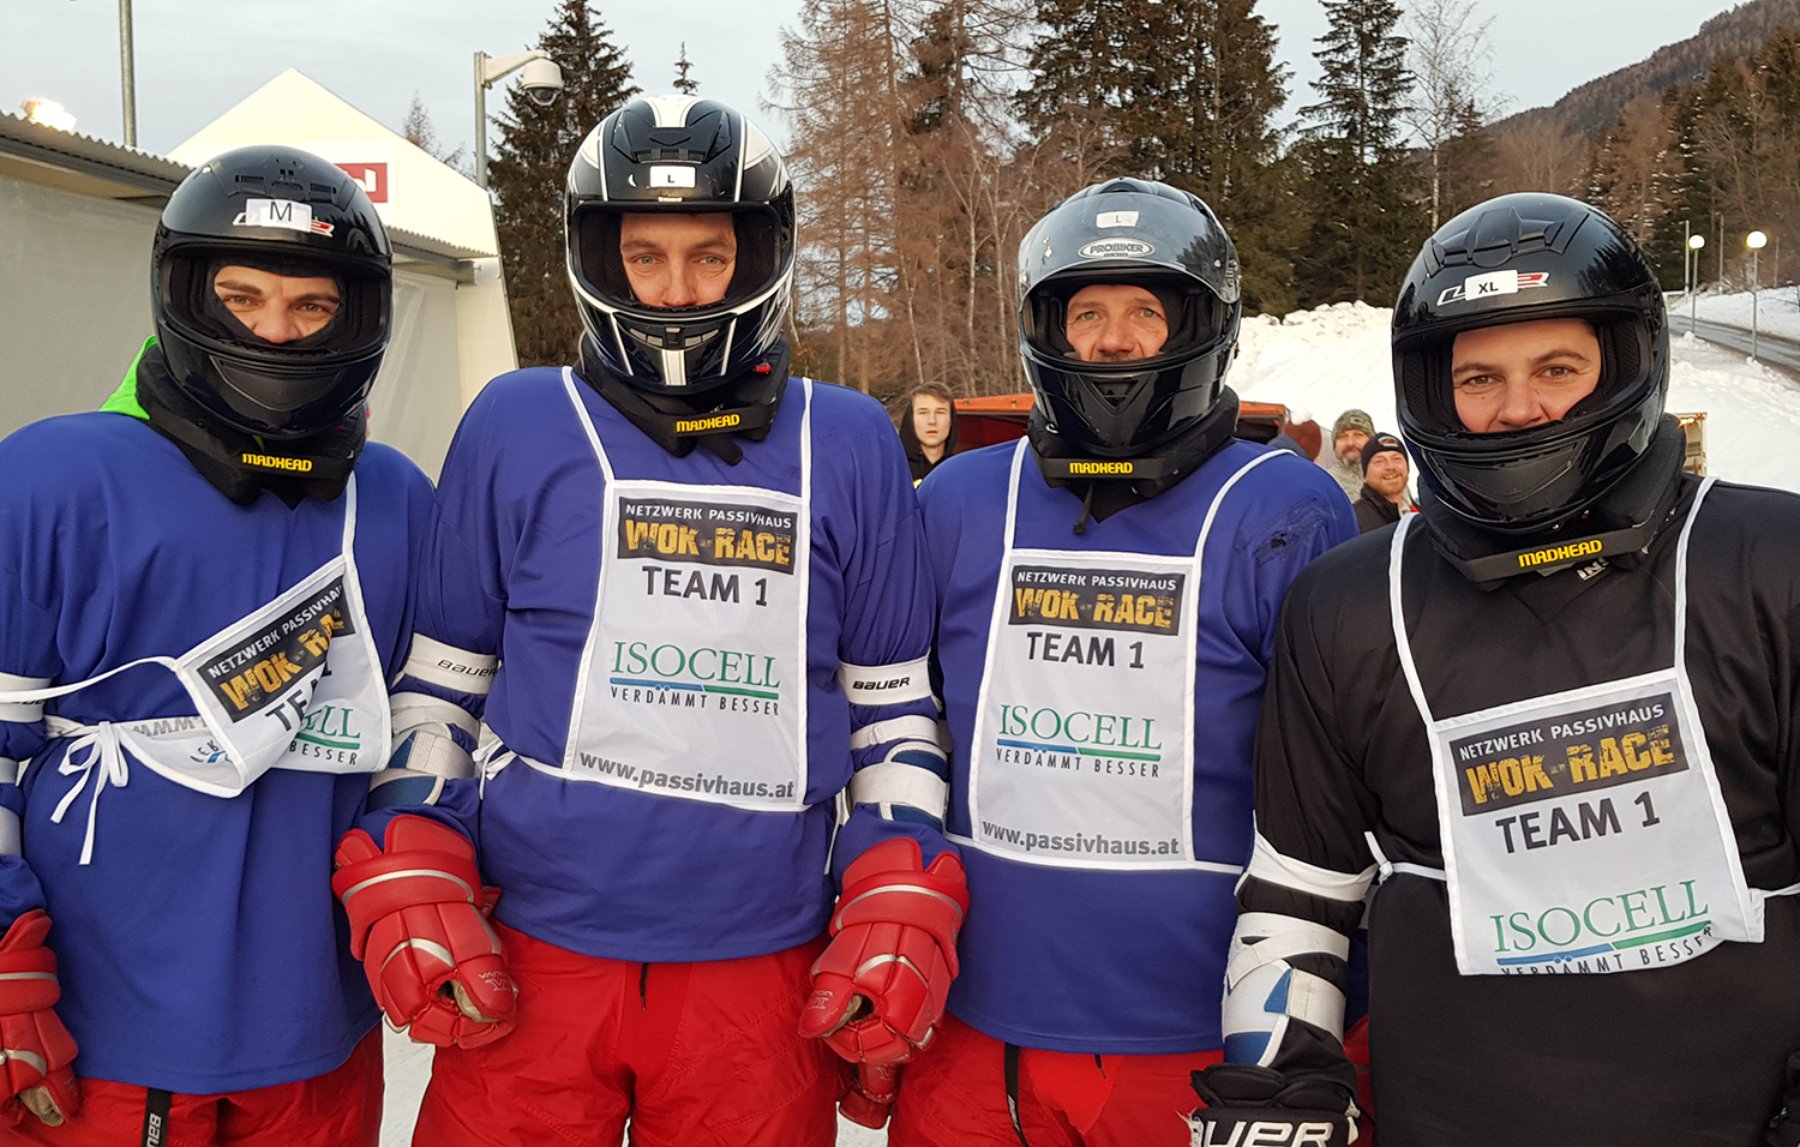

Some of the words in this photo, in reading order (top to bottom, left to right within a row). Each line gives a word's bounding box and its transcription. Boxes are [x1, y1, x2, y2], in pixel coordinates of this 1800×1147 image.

[667, 174, 676, 184] L
[269, 201, 292, 222] M
[1115, 215, 1122, 224] L
[1090, 243, 1144, 254] PROBIKER
[1478, 281, 1499, 295] XL
[676, 413, 740, 433] MADHEAD
[241, 453, 313, 472] MADHEAD
[1069, 462, 1133, 474] MADHEAD
[625, 503, 703, 520] NETZWERK
[709, 508, 792, 529] PASSIVHAUS
[625, 518, 700, 555] WOK
[715, 527, 793, 566] RACE
[1518, 539, 1603, 567] MADHEAD
[642, 565, 741, 604] TEAM
[754, 577, 768, 607] 1
[1016, 570, 1087, 587] NETZWERK
[1091, 575, 1177, 591] PASSIVHAUS
[1015, 587, 1080, 621] WOK
[1092, 593, 1174, 629] RACE
[207, 631, 281, 680] NETZWERK
[281, 585, 343, 636] PASSIVHA
[1026, 631, 1116, 667] TEAM
[1128, 641, 1145, 669] 1
[219, 652, 304, 712] WOK
[610, 641, 782, 689] ISOCELL
[719, 697, 780, 716] BESSER
[997, 704, 1163, 751] ISOCELL
[1459, 728, 1545, 761] NETZWERK
[1551, 703, 1665, 740] PASSIVHAUS
[288, 739, 359, 767] BESSER
[1093, 758, 1160, 778] BESSER
[1465, 754, 1554, 805] WOK
[1565, 724, 1676, 785] RACE
[579, 752, 794, 799] www.passivhaus.at
[981, 821, 1180, 856] www.passivhaus.at
[1495, 798, 1623, 854] TEAM
[1633, 791, 1661, 828] 1
[1489, 879, 1710, 953] ISOCELL
[146, 1112, 162, 1147] BAU
